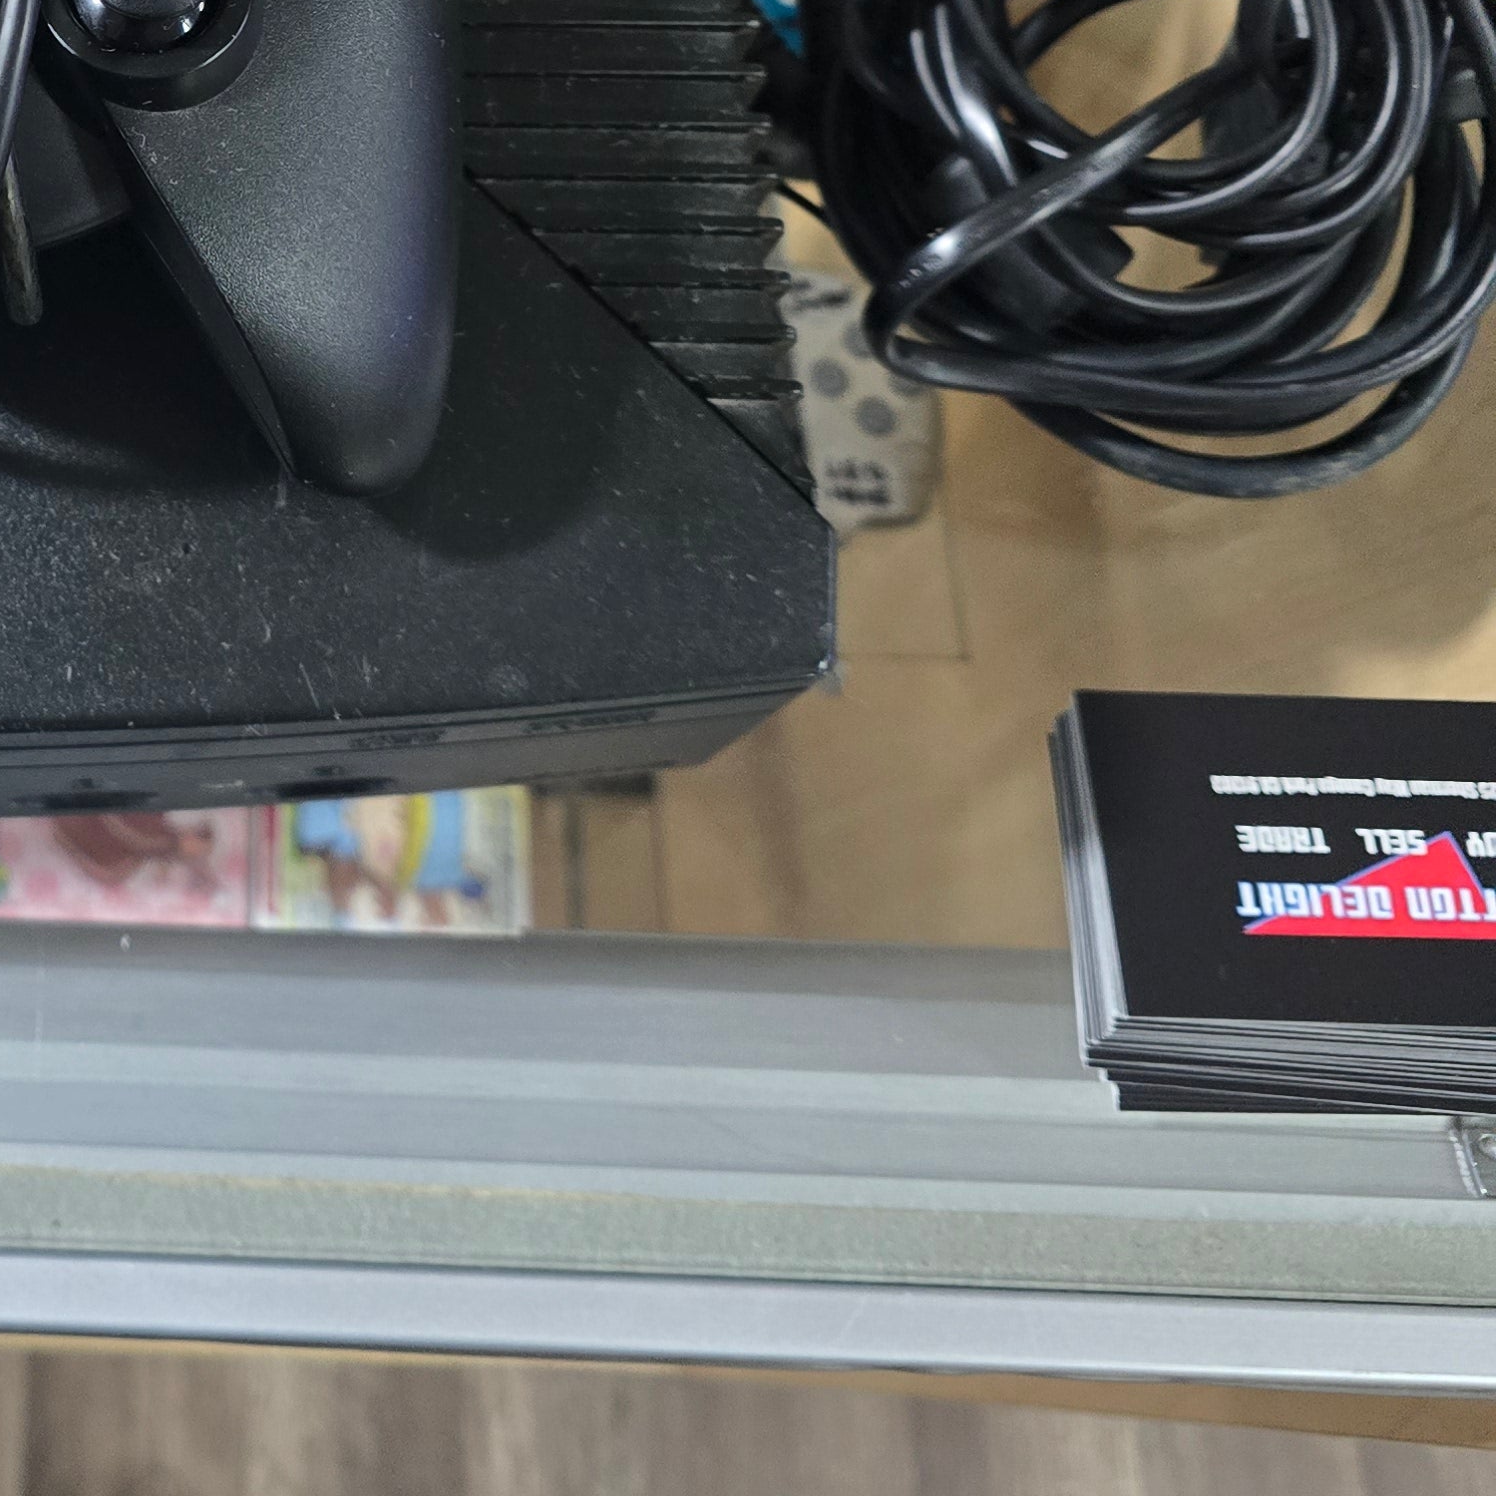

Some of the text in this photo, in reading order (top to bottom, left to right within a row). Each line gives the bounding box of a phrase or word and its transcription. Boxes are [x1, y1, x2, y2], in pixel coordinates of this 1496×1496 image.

[1234, 825, 1332, 855] TRADE
[1354, 827, 1429, 856] SELL
[1235, 881, 1396, 920] DELIGHT
